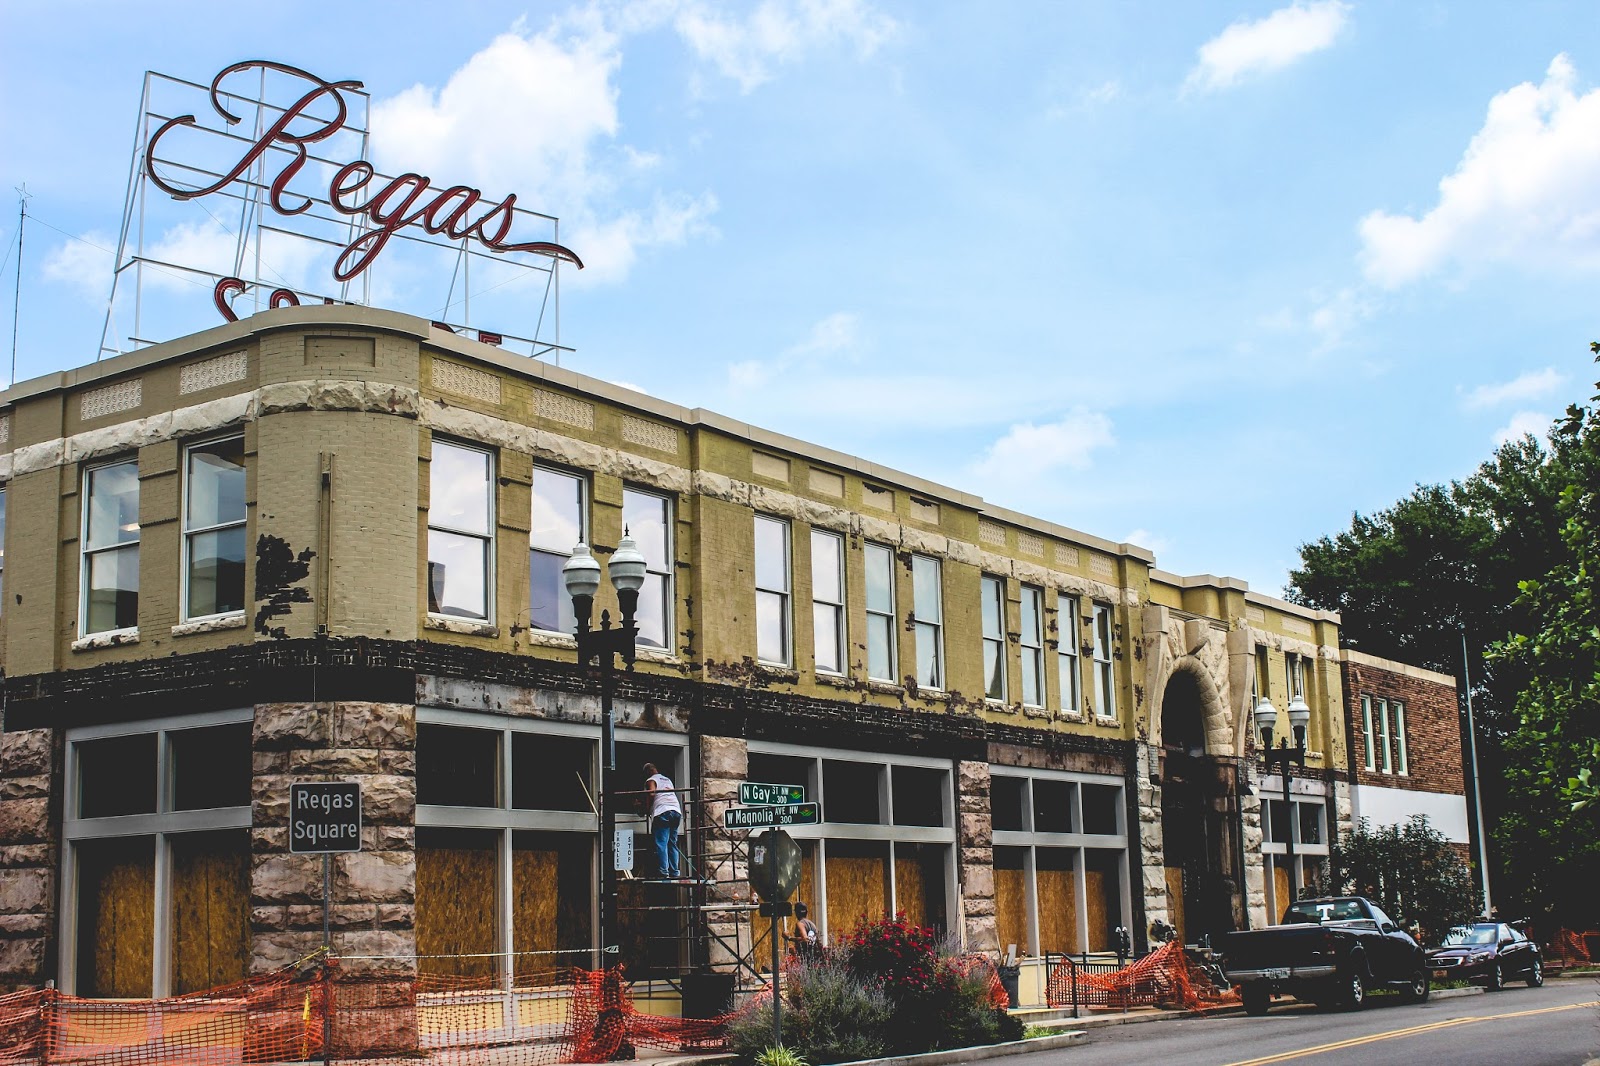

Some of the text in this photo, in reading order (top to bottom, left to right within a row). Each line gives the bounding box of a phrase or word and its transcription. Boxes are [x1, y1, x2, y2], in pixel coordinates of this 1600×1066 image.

[146, 60, 584, 282] Regas
[297, 790, 354, 815] Regas
[743, 785, 789, 804] N Gay ST NW
[777, 795, 788, 804] 300
[727, 806, 799, 826] W Magnolia AVE NW
[780, 815, 792, 824] 300
[294, 820, 357, 845] Square
[1316, 904, 1335, 921] T
